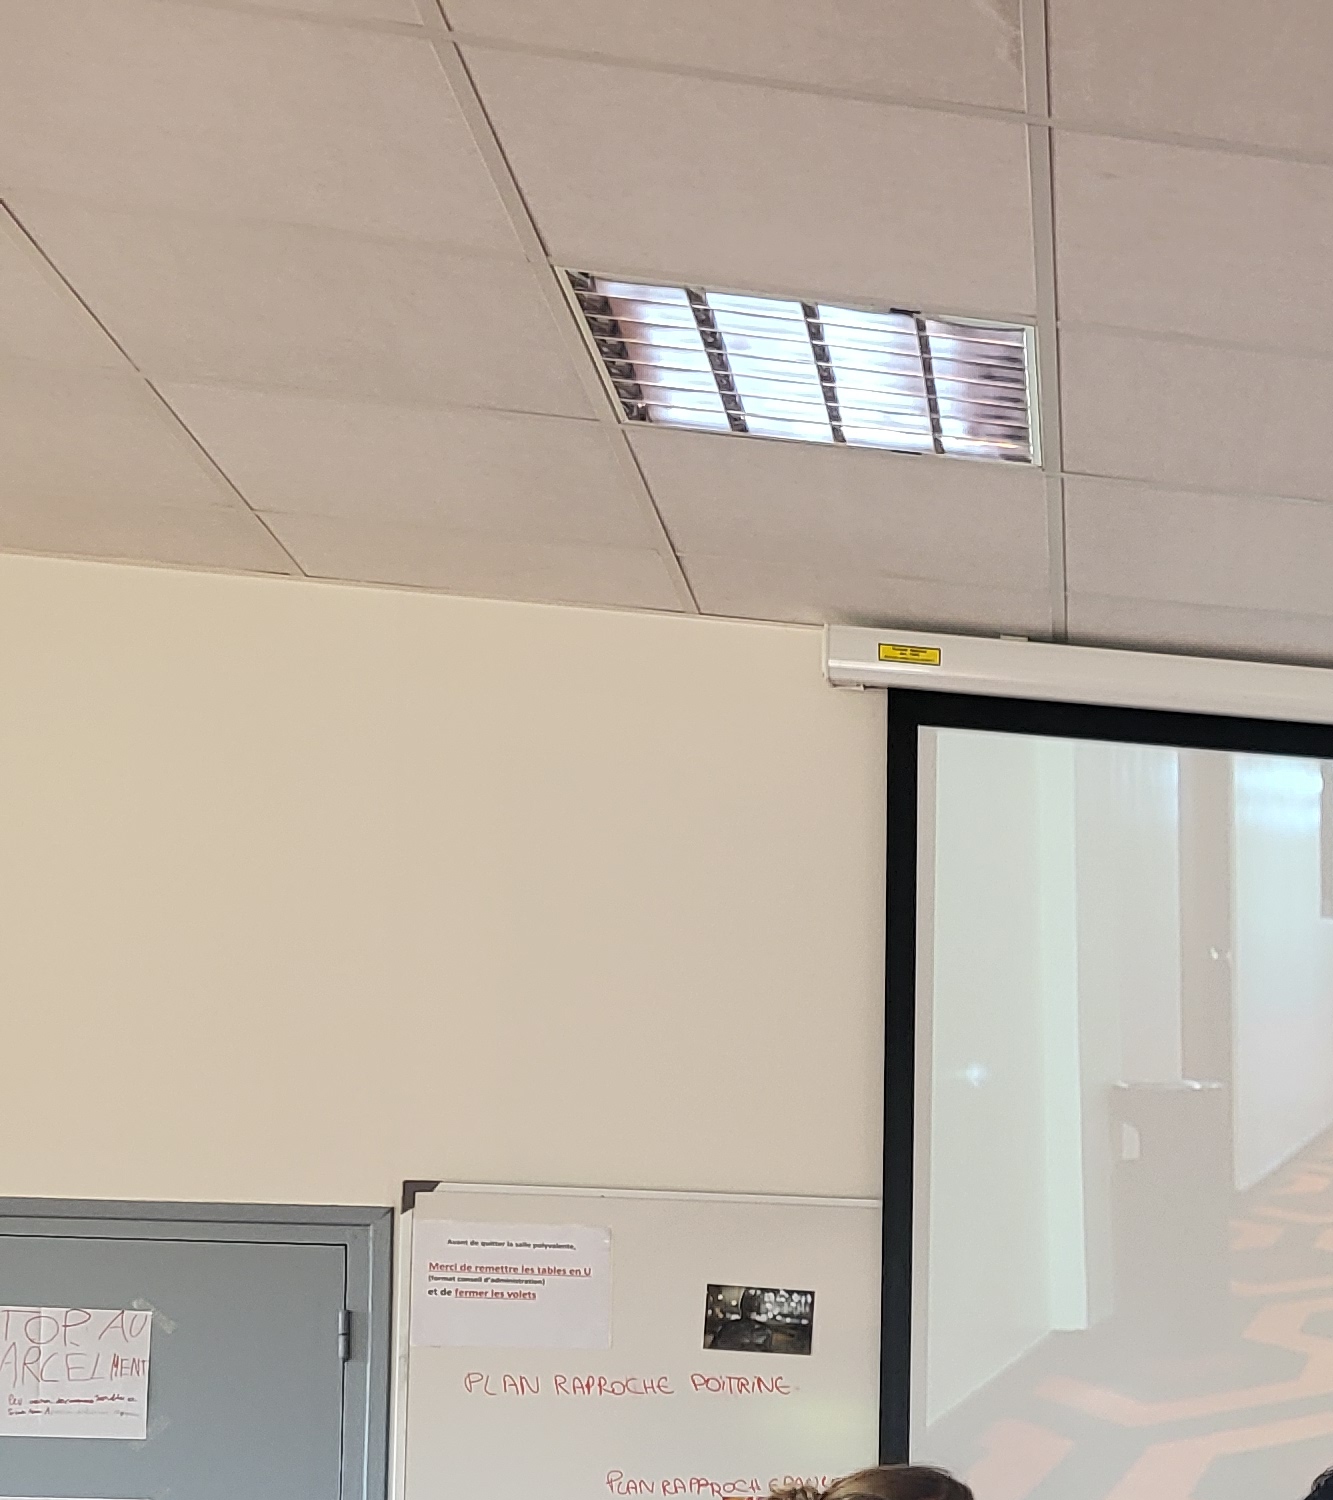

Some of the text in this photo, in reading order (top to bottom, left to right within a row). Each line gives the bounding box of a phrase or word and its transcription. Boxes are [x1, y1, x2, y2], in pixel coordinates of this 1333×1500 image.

[429, 1262, 592, 1276] Merci de remettre les tables en U
[428, 1288, 537, 1299] et de fermer les volets
[1, 1308, 148, 1346] TOP AU
[464, 1372, 540, 1396] PLAN
[554, 1374, 674, 1396] RAPROCHE
[606, 1469, 654, 1495] PLAN
